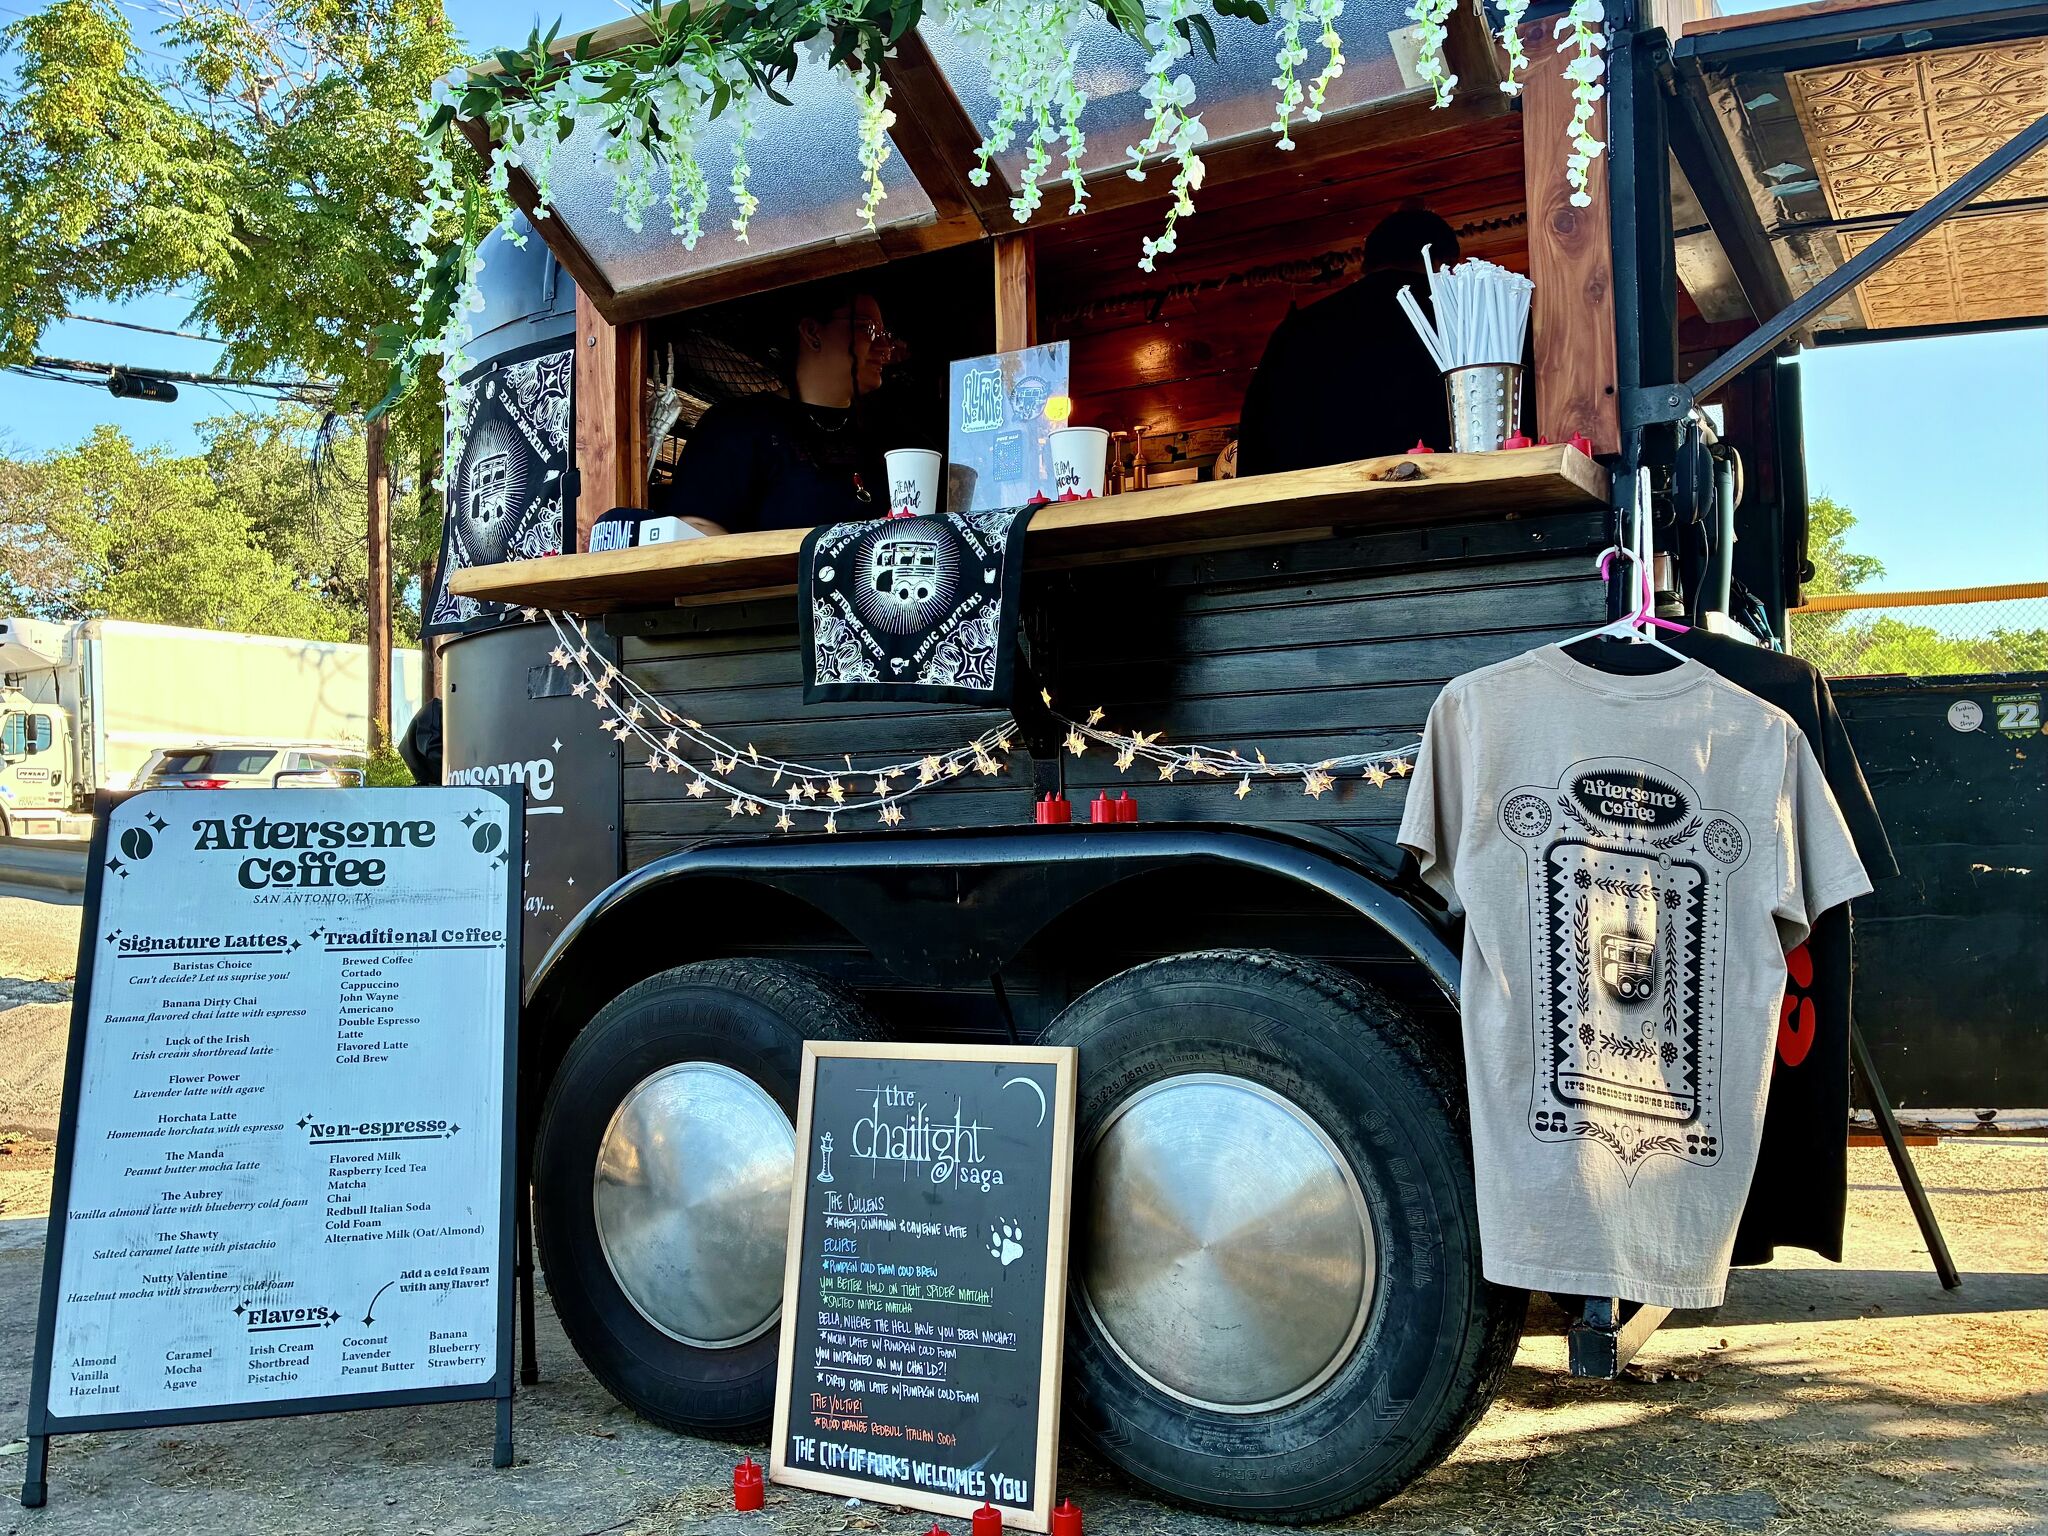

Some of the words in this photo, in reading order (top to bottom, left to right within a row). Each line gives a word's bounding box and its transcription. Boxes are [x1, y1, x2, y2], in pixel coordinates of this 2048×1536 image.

[1057, 467, 1081, 488] acob
[896, 480, 915, 494] TEAM
[892, 489, 921, 508] dward
[913, 631, 939, 664] MAGIC
[939, 592, 983, 634] HAPPENS
[1997, 703, 2040, 729] 22
[1582, 779, 1676, 809] Aftersome
[1601, 801, 1655, 822] Coffee
[192, 814, 436, 850] Aftersome
[238, 851, 386, 890] Coffee
[253, 894, 281, 904] SAN
[356, 893, 373, 903] TX
[118, 934, 220, 953] Signature
[224, 934, 288, 948] Lattes
[324, 928, 438, 945] Traditional
[441, 928, 502, 942] Coffee
[173, 962, 214, 970] Baristas
[216, 960, 252, 970] Choice
[342, 956, 379, 966] Brewed
[382, 956, 413, 964] Coffee
[129, 975, 157, 985] Can't
[158, 974, 198, 984] decide?
[198, 974, 216, 982] Let
[216, 974, 229, 982] us
[230, 972, 267, 983] suprise
[267, 971, 291, 982] you!
[341, 968, 382, 978] Cortado
[340, 980, 400, 992] Cappuccino
[162, 1000, 201, 1008] Banana
[203, 998, 232, 1009] Dirty
[233, 996, 257, 1006] Chai
[339, 993, 363, 1004] John
[365, 992, 399, 1003] Wayne
[104, 1014, 145, 1024] Banana
[144, 1010, 190, 1024] flavored
[191, 1010, 214, 1020] chai
[215, 1009, 240, 1019] latte
[242, 1008, 264, 1018] with
[266, 1010, 307, 1019] espresso
[338, 1005, 394, 1014] Americano
[338, 1016, 375, 1026] Double
[377, 1016, 420, 1027] Espresso
[165, 1036, 191, 1046] Luck
[193, 1035, 206, 1044] of
[206, 1035, 224, 1044] the
[226, 1034, 250, 1044] Irish
[338, 1030, 364, 1039] Latte
[336, 1041, 380, 1052] Flavored
[382, 1041, 409, 1050] Latte
[336, 1054, 360, 1064] Cold
[362, 1054, 389, 1063] Brew
[169, 1074, 205, 1084] Flower
[208, 1073, 240, 1082] Power
[885, 1084, 916, 1107] the
[1597, 1087, 1632, 1101] ACCIDENT
[158, 1113, 207, 1124] Horchata
[209, 1112, 237, 1120] Latte
[309, 1120, 447, 1137] Non-espresso
[164, 1151, 185, 1161] The
[187, 1149, 224, 1160] Manda
[329, 1152, 374, 1164] Flavored
[376, 1151, 401, 1161] Milk
[328, 1166, 382, 1178] Raspberry
[384, 1164, 406, 1174] Iced
[408, 1164, 427, 1172] Tea
[328, 1179, 366, 1190] Matcha
[960, 1167, 1004, 1192] saga
[161, 1191, 181, 1201] The
[183, 1190, 223, 1200] Aubrey
[326, 1193, 351, 1204] Chai
[824, 1190, 843, 1211] THE
[326, 1205, 367, 1216] Redbull
[369, 1204, 403, 1214] Italian
[406, 1202, 431, 1212] Soda
[325, 1219, 350, 1230] Cold
[353, 1219, 382, 1228] Foam
[156, 1232, 177, 1242] The
[179, 1230, 219, 1241] Shawty
[324, 1232, 384, 1244] Alternative
[385, 1229, 410, 1240] Milk
[412, 1224, 484, 1239] (Oat/Almond)
[142, 1274, 174, 1286] Nutty
[176, 1270, 228, 1282] Valentine
[819, 1276, 834, 1296] YOU
[837, 1276, 862, 1292] BETTER
[866, 1281, 884, 1294] HOLD
[888, 1282, 898, 1295] ON
[247, 1306, 328, 1325] Flavors
[429, 1331, 468, 1340] Banana
[874, 1318, 890, 1333] THE
[891, 1319, 912, 1334] HELL
[914, 1322, 934, 1336] HAVE
[937, 1326, 954, 1342] YOU
[956, 1328, 978, 1340] BEEN
[342, 1336, 388, 1347] Coconut
[428, 1342, 481, 1354] Blueberry
[249, 1344, 275, 1356] Irish
[278, 1343, 314, 1353] Cream
[71, 1354, 116, 1368] Almond
[428, 1356, 486, 1368] Strawberry
[815, 1346, 830, 1367] YOU
[876, 1356, 886, 1370] ON
[889, 1359, 902, 1376] MY
[341, 1364, 378, 1376] Peanut
[381, 1362, 415, 1372] Butter
[248, 1371, 298, 1385] Pistachio
[69, 1384, 120, 1396] Hazelnut
[810, 1392, 828, 1410] THE
[792, 1435, 816, 1462] THE
[820, 1441, 846, 1470] CITY
[848, 1447, 866, 1471] OF
[867, 1451, 910, 1480] FORKS
[912, 1460, 985, 1496] WELCOMES
[990, 1472, 1027, 1502] YOU
